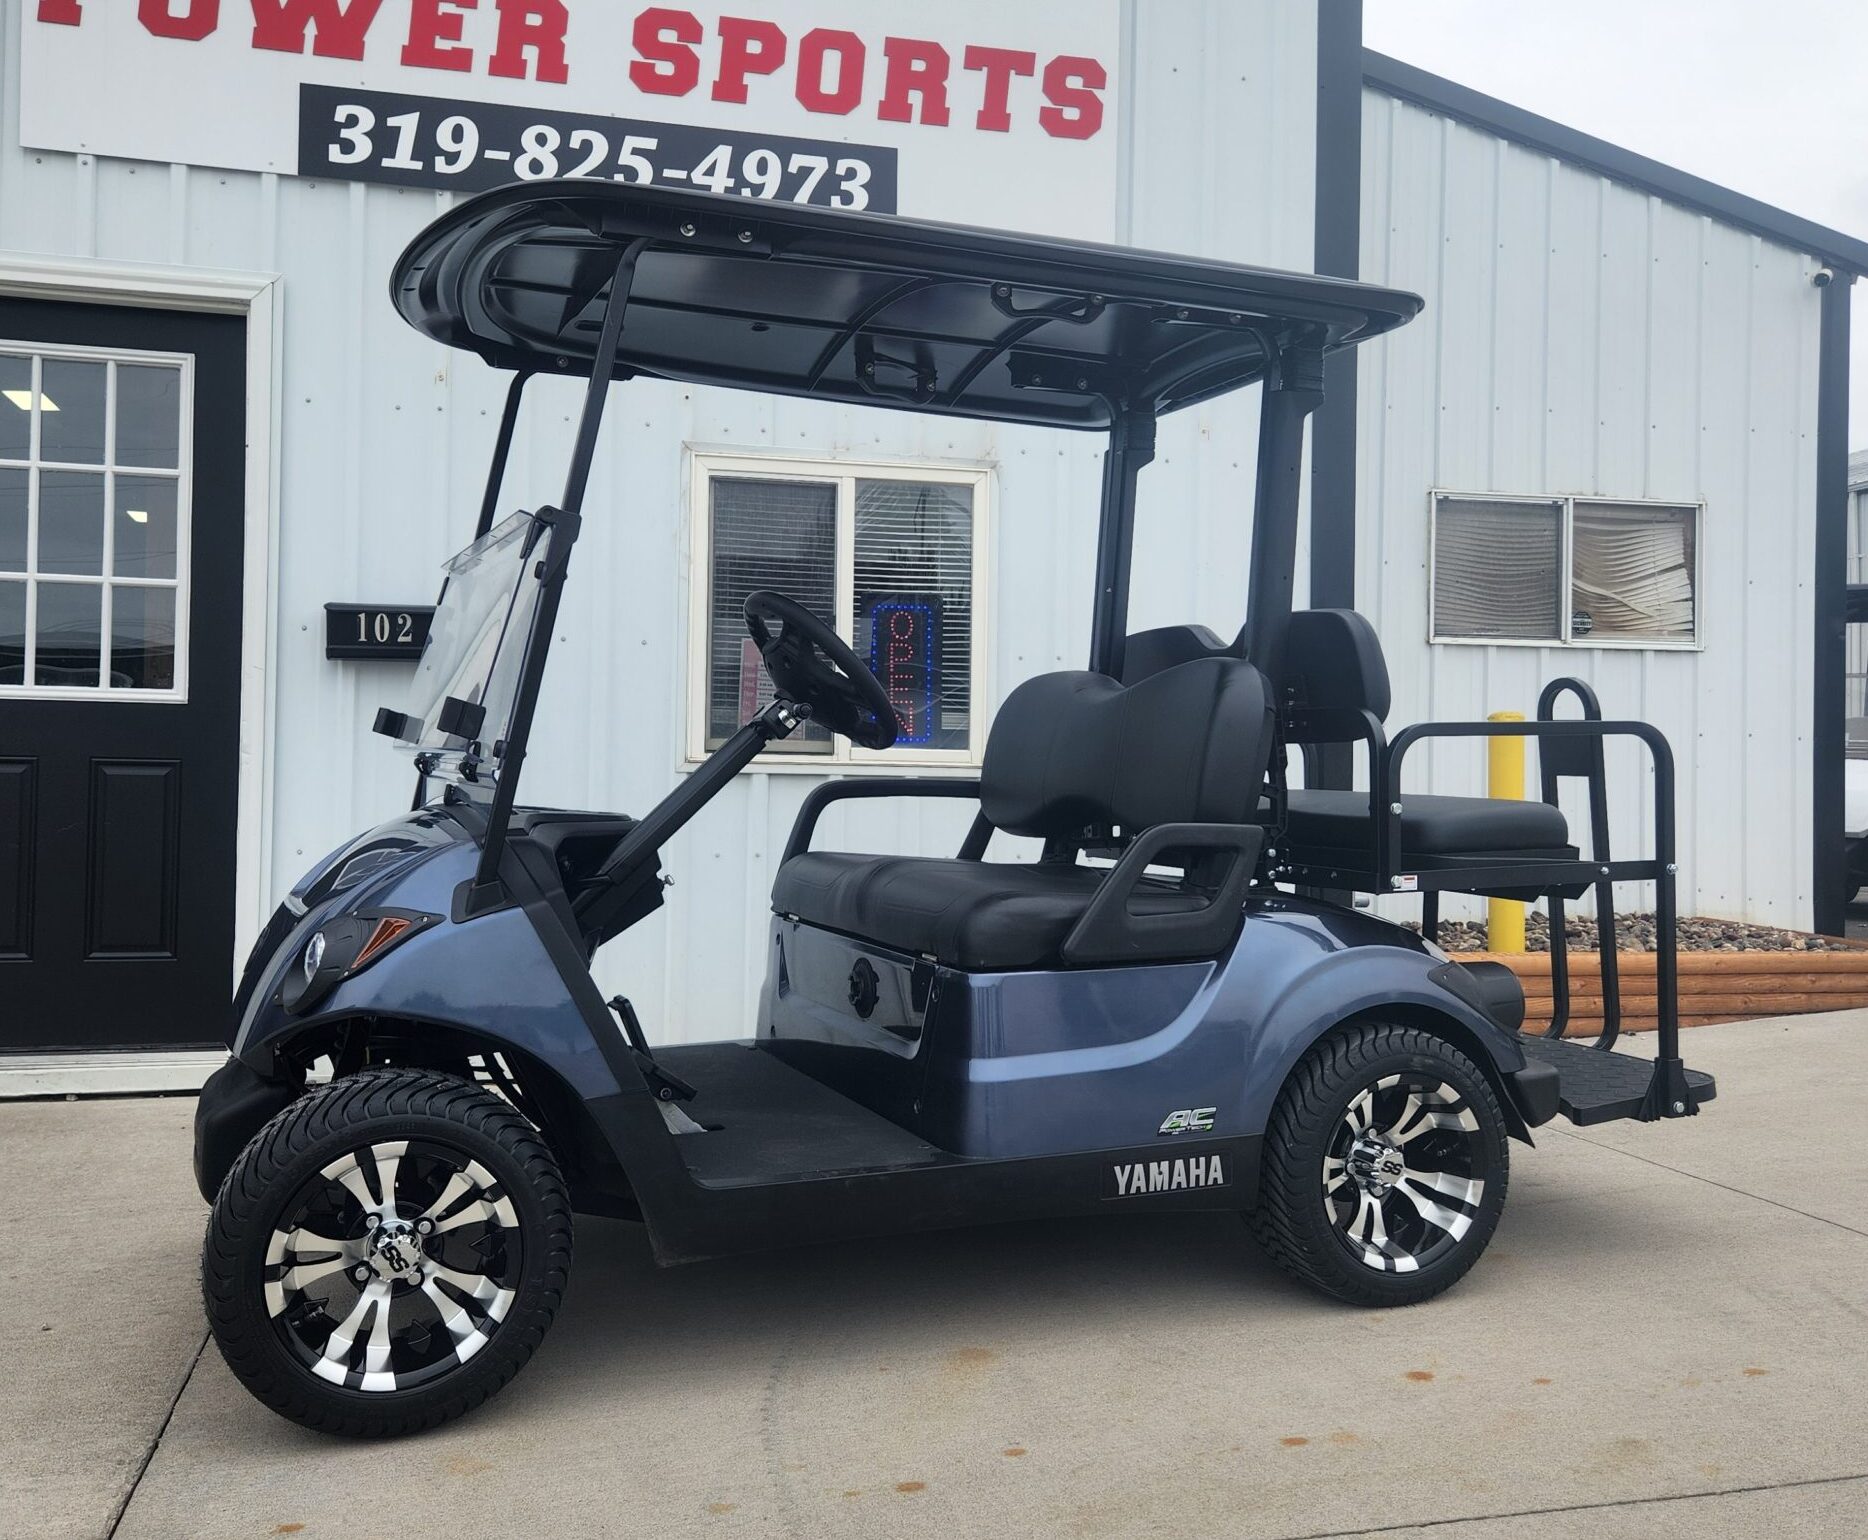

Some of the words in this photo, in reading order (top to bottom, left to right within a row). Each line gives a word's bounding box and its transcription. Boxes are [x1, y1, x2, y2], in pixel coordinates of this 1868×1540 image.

[37, 0, 569, 84] WER
[629, 7, 1107, 140] SPORTS
[328, 104, 872, 211] 319-825-4973
[358, 612, 413, 643] 102
[1114, 1155, 1224, 1195] YAMAHA
